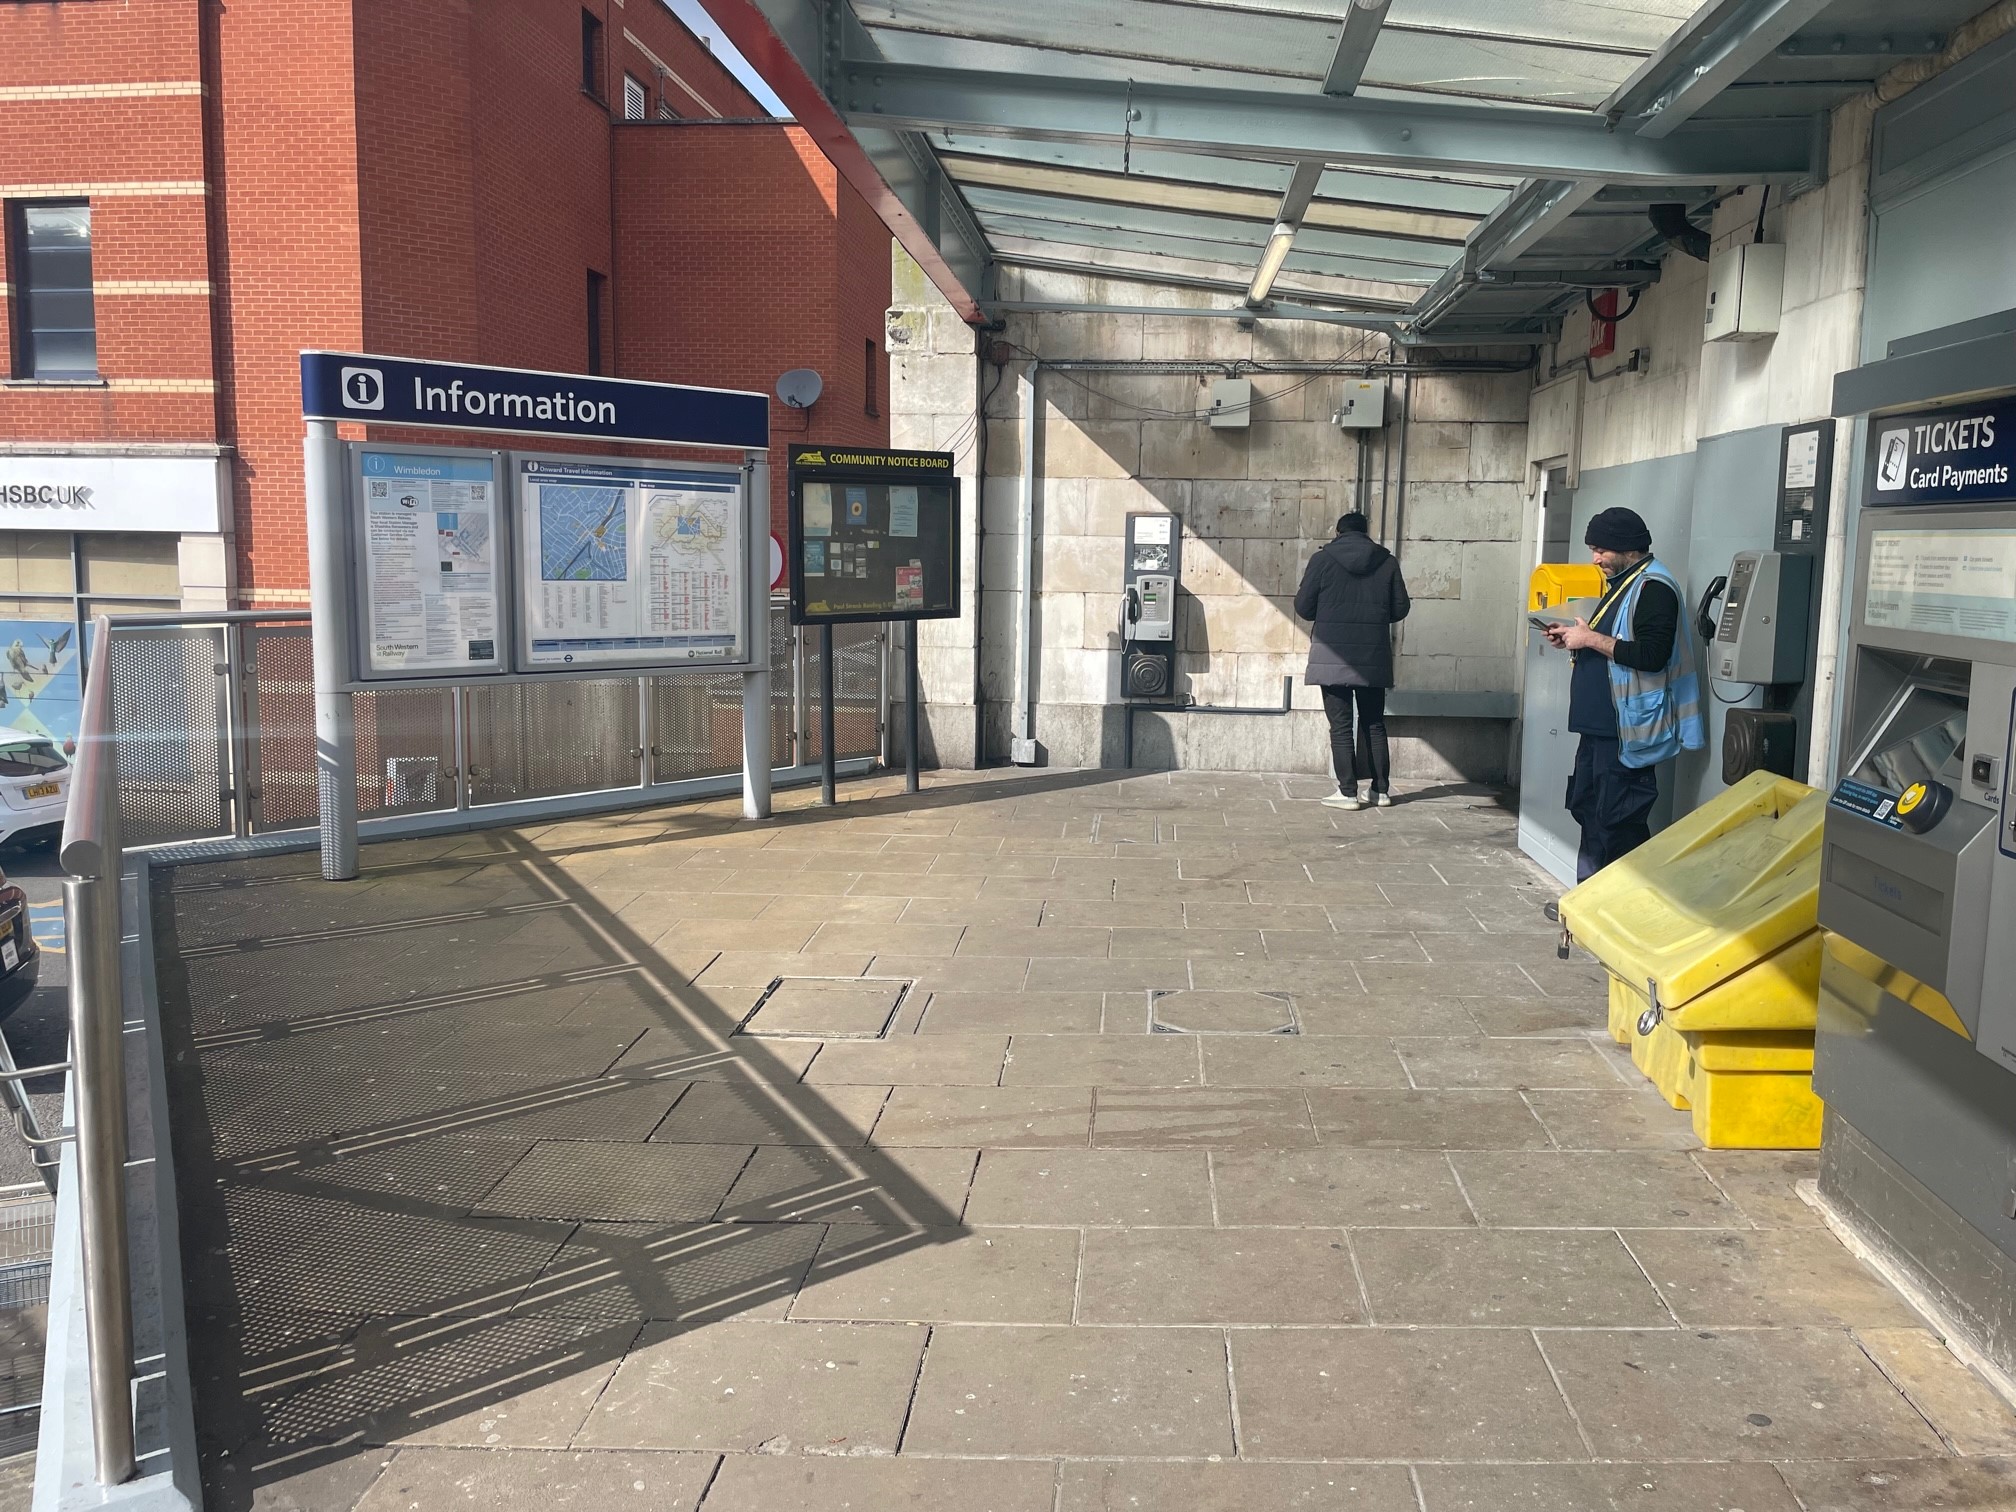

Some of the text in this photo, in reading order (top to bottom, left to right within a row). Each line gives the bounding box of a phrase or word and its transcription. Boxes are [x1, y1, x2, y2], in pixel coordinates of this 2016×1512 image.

[414, 376, 617, 424] Information
[1914, 415, 1995, 455] TICKETS
[830, 453, 886, 466] COMMUNITY
[888, 456, 919, 467] NOTICE
[920, 457, 949, 469] BOARD
[394, 465, 441, 476] Wimbledon
[564, 467, 580, 475] Travel
[581, 468, 613, 476] Information
[1910, 463, 2008, 491] Card Payments
[57, 485, 86, 504] UK
[376, 644, 394, 652] South
[382, 650, 406, 658] Railway
[1984, 792, 1999, 804] Cards
